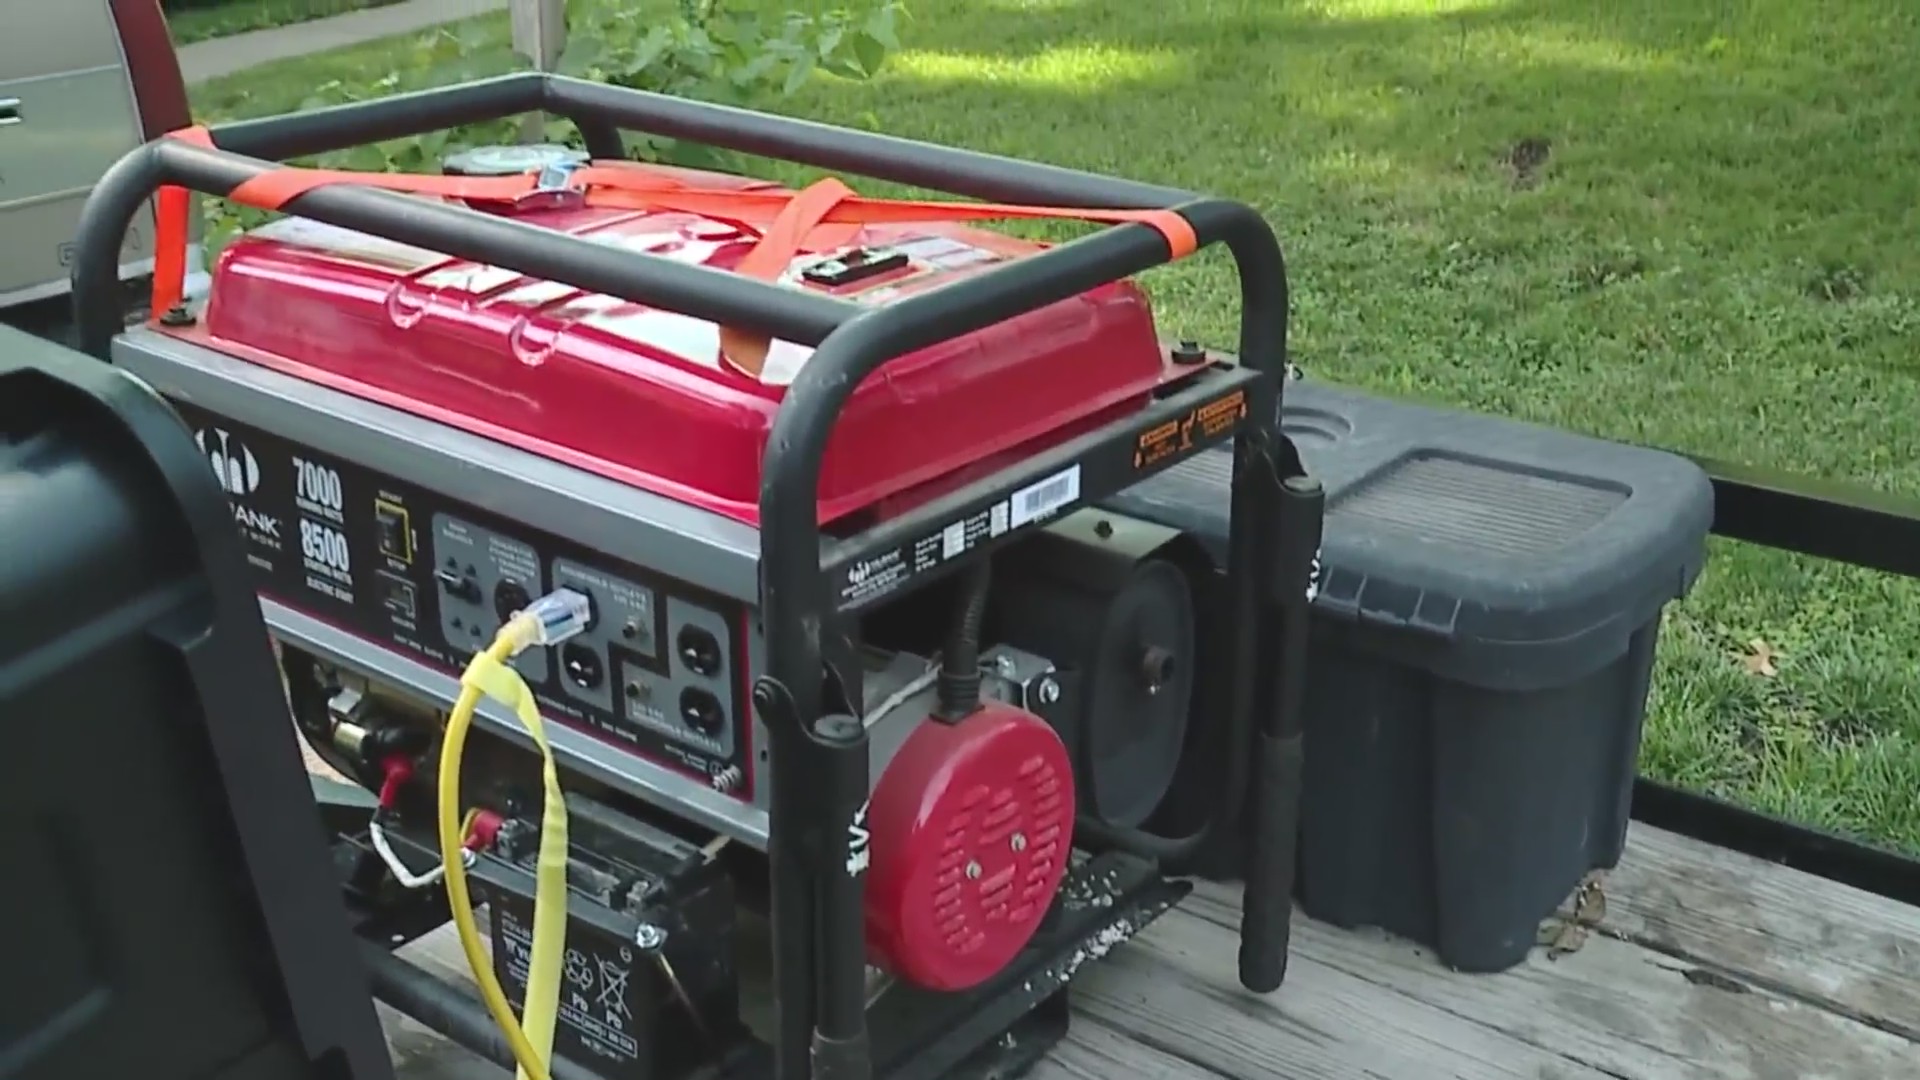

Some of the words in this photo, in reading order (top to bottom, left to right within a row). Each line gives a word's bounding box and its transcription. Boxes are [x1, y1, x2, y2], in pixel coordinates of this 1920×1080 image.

[292, 456, 342, 511] 7000
[229, 501, 280, 538] ANK
[300, 518, 350, 572] 8500
